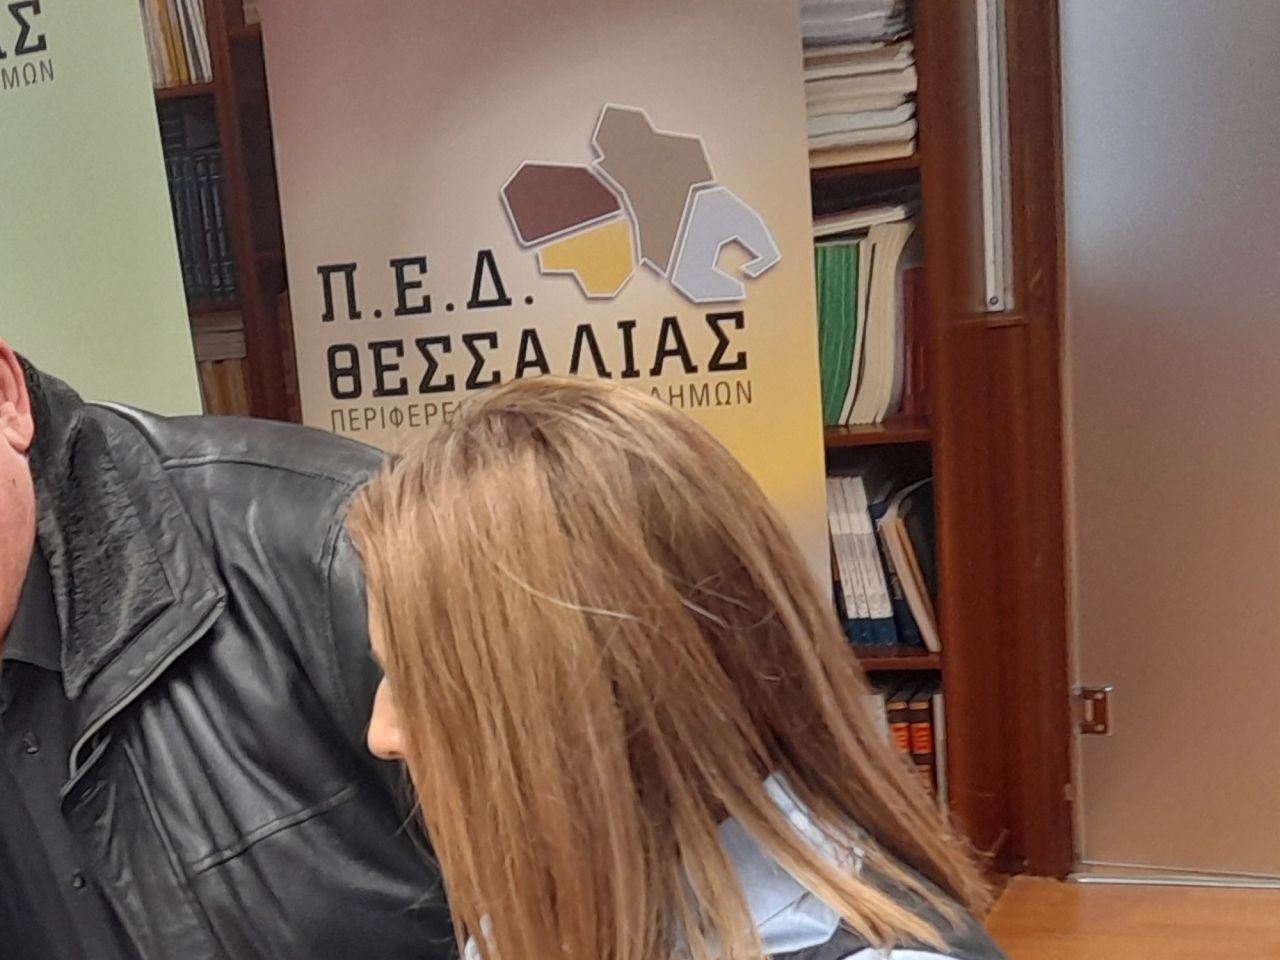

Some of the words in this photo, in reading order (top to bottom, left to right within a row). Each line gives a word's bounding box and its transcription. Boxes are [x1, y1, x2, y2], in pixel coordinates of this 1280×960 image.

[317, 249, 534, 322] Π.Ε.Δ.
[327, 311, 748, 400] ΘΕΣΣΑΛΙΑΣ
[331, 401, 462, 432] ΠΕΡΙΦΕΡΕ
